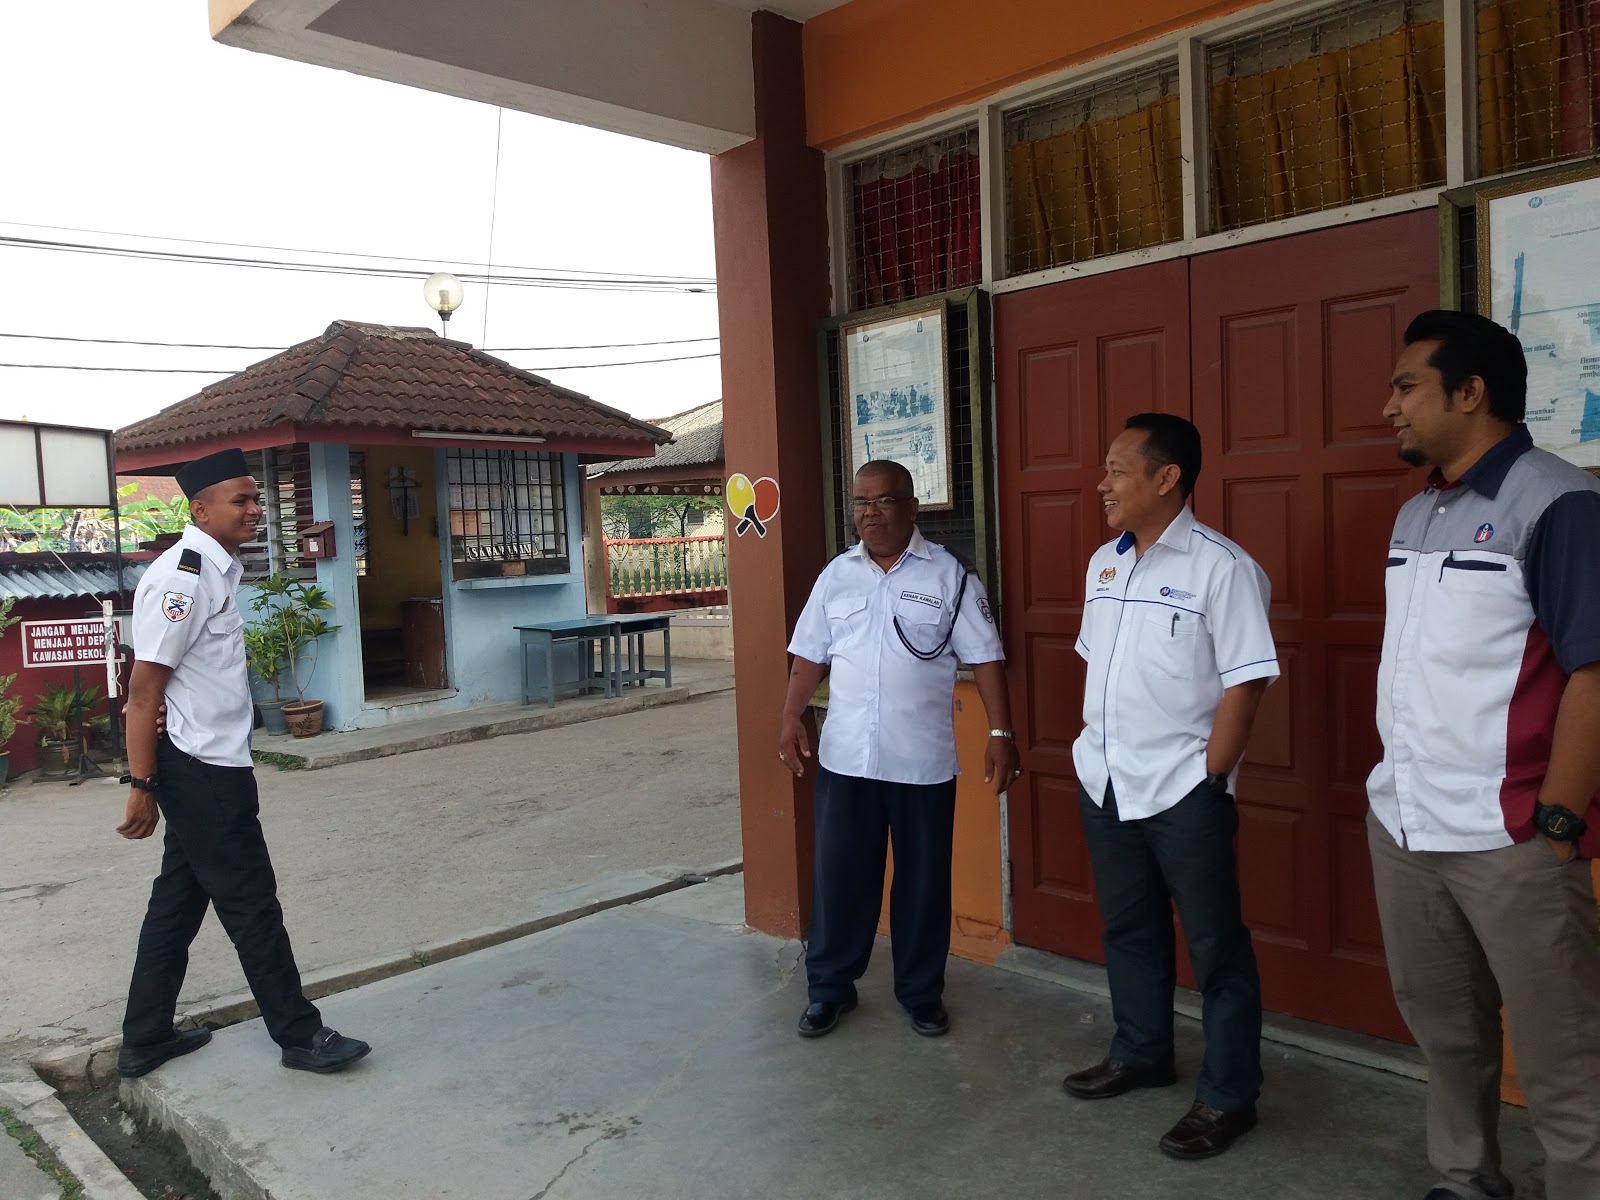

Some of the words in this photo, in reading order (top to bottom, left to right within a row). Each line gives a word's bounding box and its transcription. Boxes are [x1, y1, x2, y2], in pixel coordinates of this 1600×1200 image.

[31, 625, 65, 637] JANGAN
[71, 623, 104, 635] MENJUA
[34, 637, 73, 649] MENJAJA
[76, 636, 85, 647] DI
[88, 635, 105, 646] DEP
[33, 650, 74, 662] KAWASAN
[77, 648, 106, 660] SEKOL
